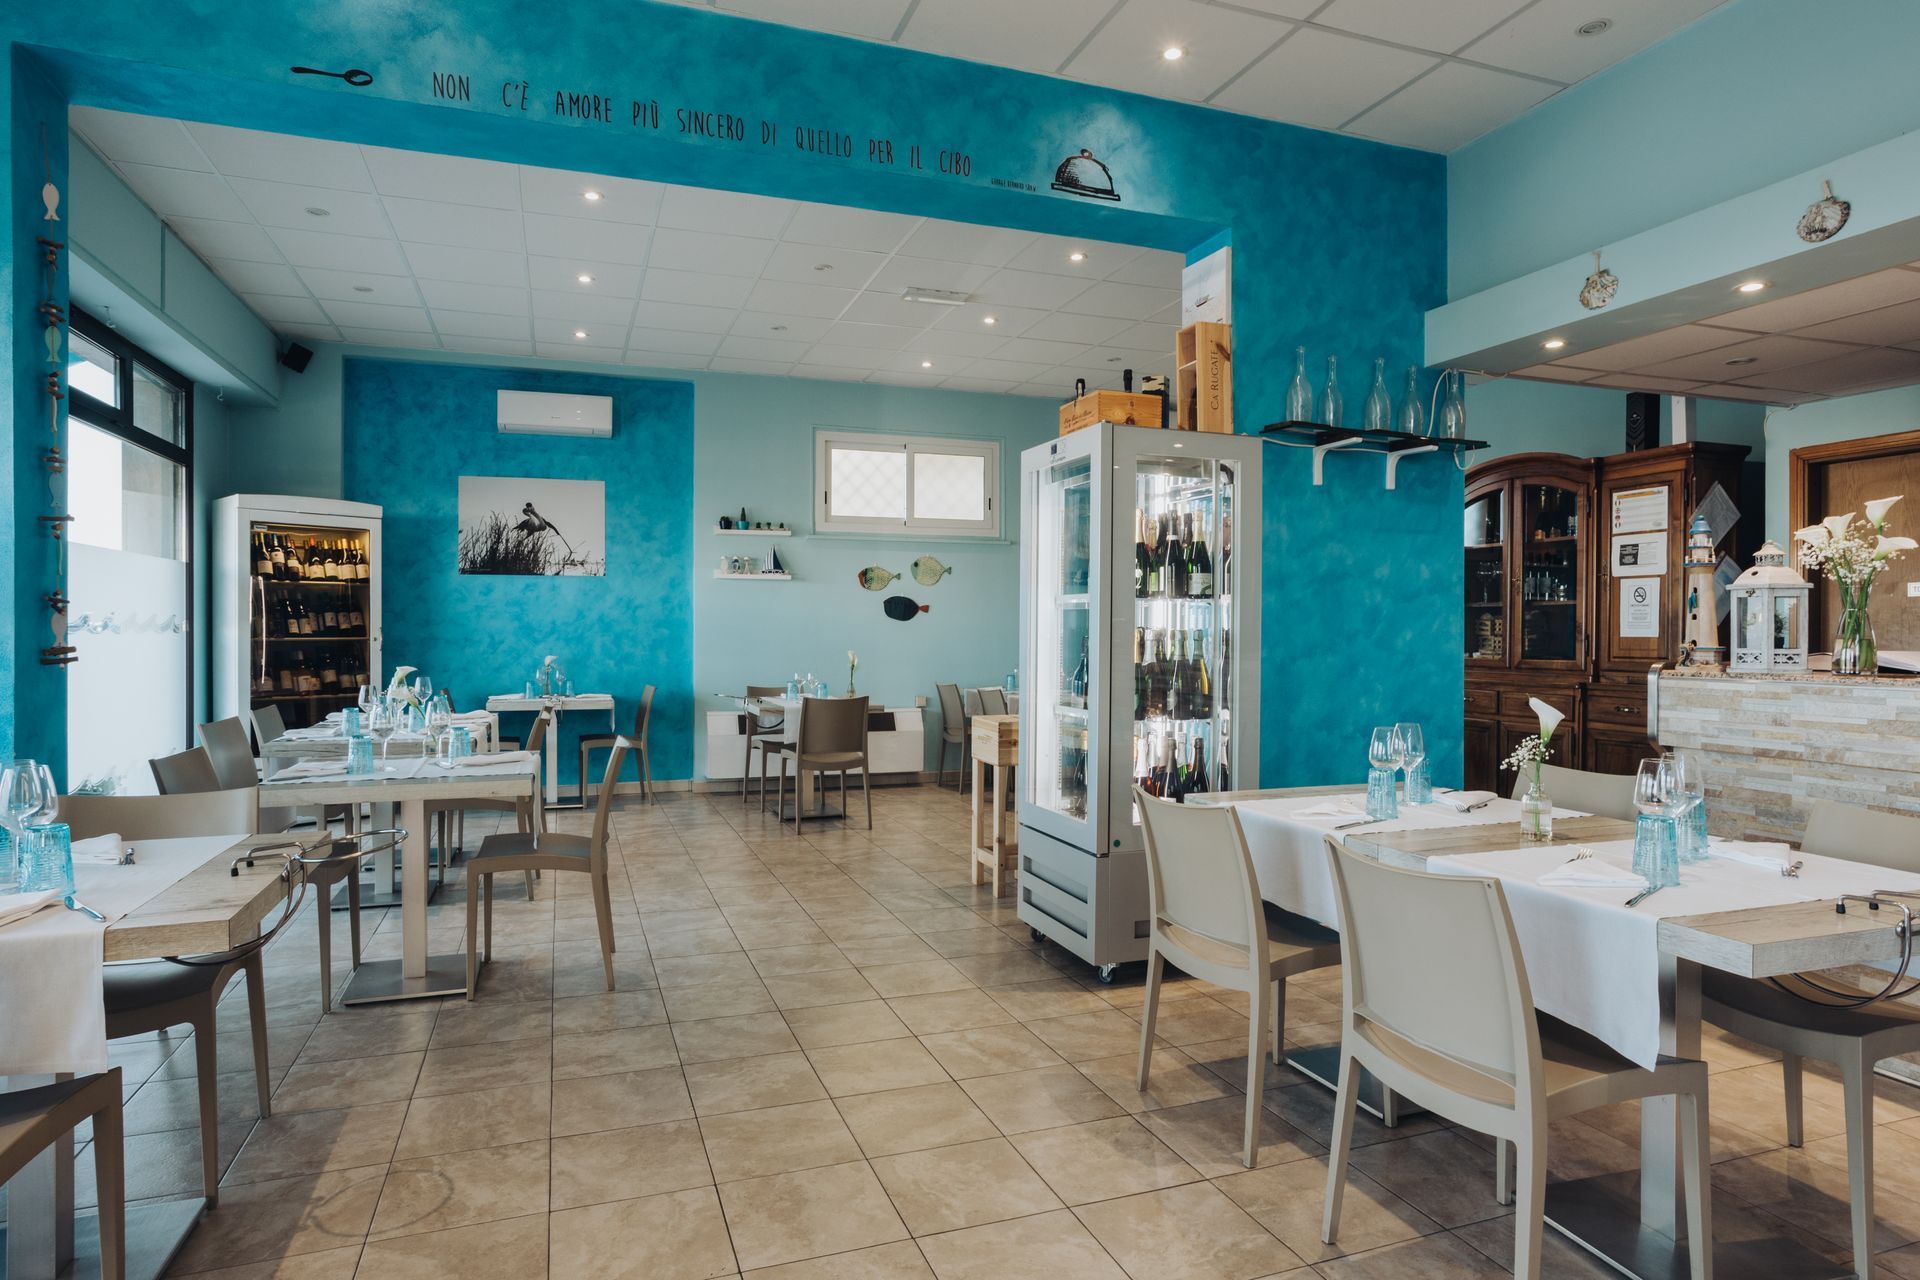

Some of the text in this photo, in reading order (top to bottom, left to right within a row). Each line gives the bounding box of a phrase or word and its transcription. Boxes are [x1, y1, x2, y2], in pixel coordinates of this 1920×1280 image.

[432, 71, 971, 177] NON C'È AMORE PIÙ SINCERO DI QUELLO PER IL CIBO
